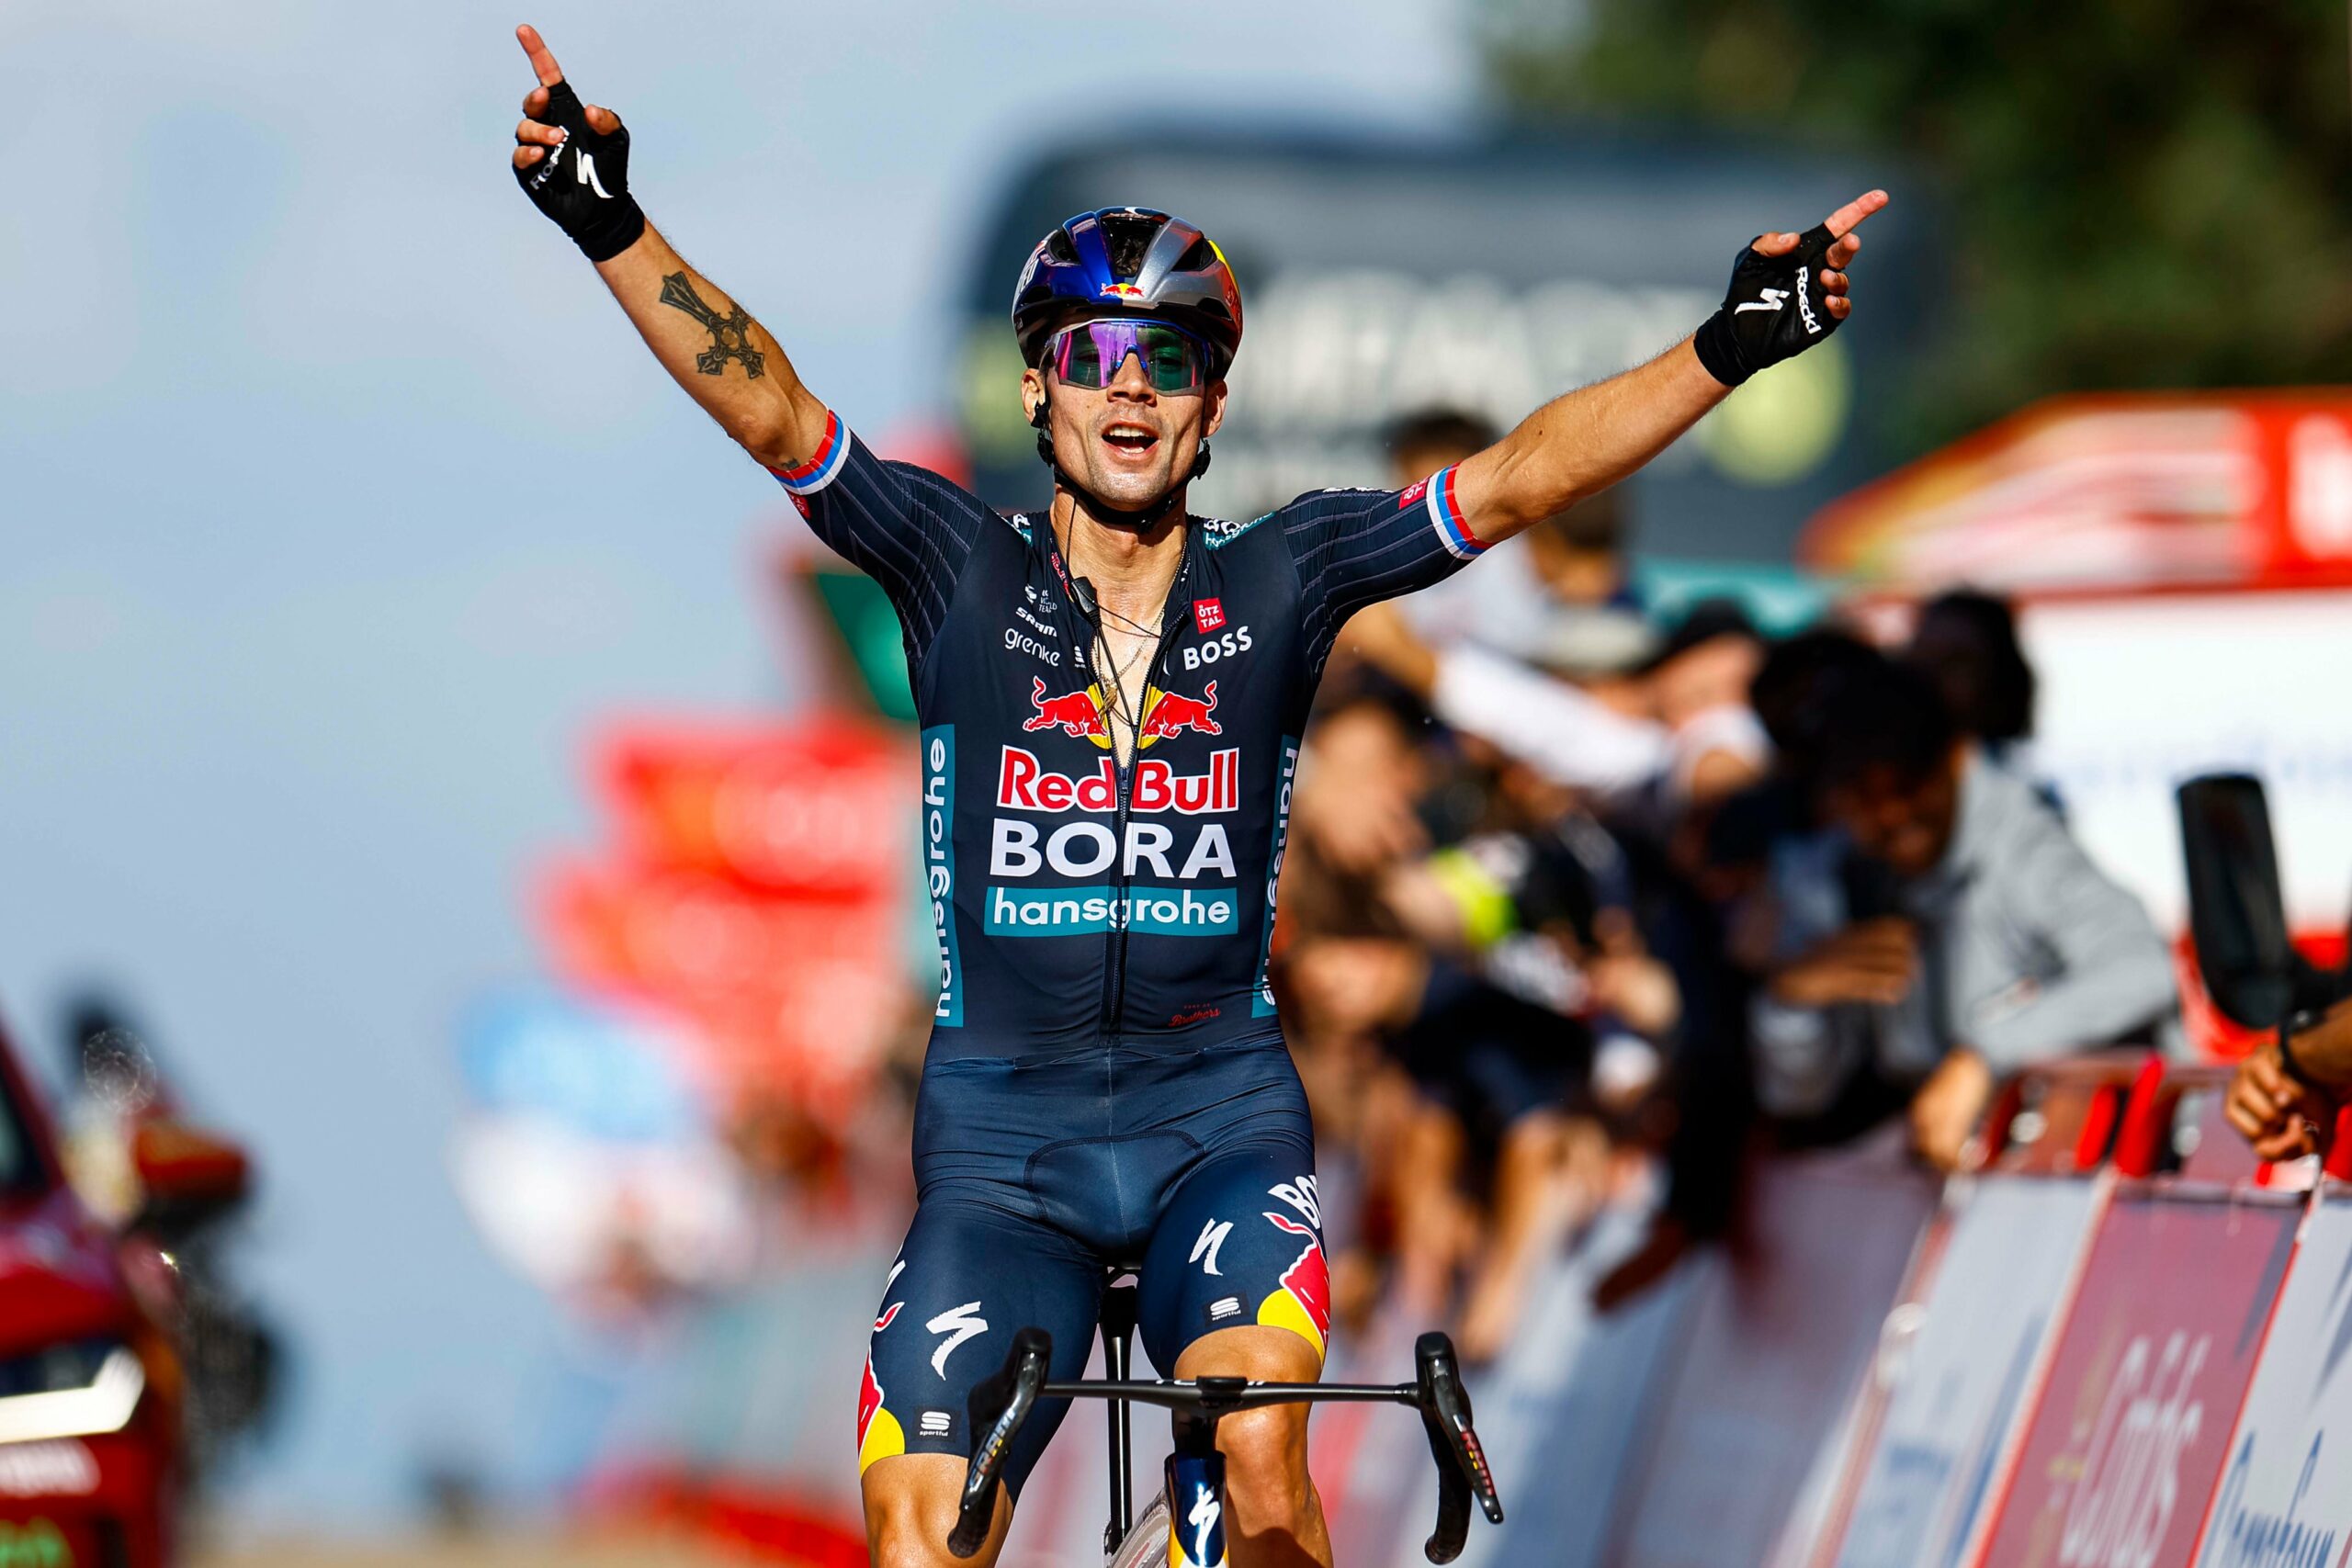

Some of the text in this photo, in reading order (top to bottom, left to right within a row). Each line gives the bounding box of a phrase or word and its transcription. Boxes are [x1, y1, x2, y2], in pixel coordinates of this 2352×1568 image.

[1015, 606, 1057, 637] SRAM
[1198, 604, 1219, 618] ÖTZ
[1200, 615, 1223, 629] TAL
[1004, 627, 1061, 667] grenke
[1182, 626, 1253, 671] BOSS
[997, 744, 1239, 815] Red Bull
[989, 818, 1238, 879] BORA
[993, 886, 1231, 930] hansgrohe
